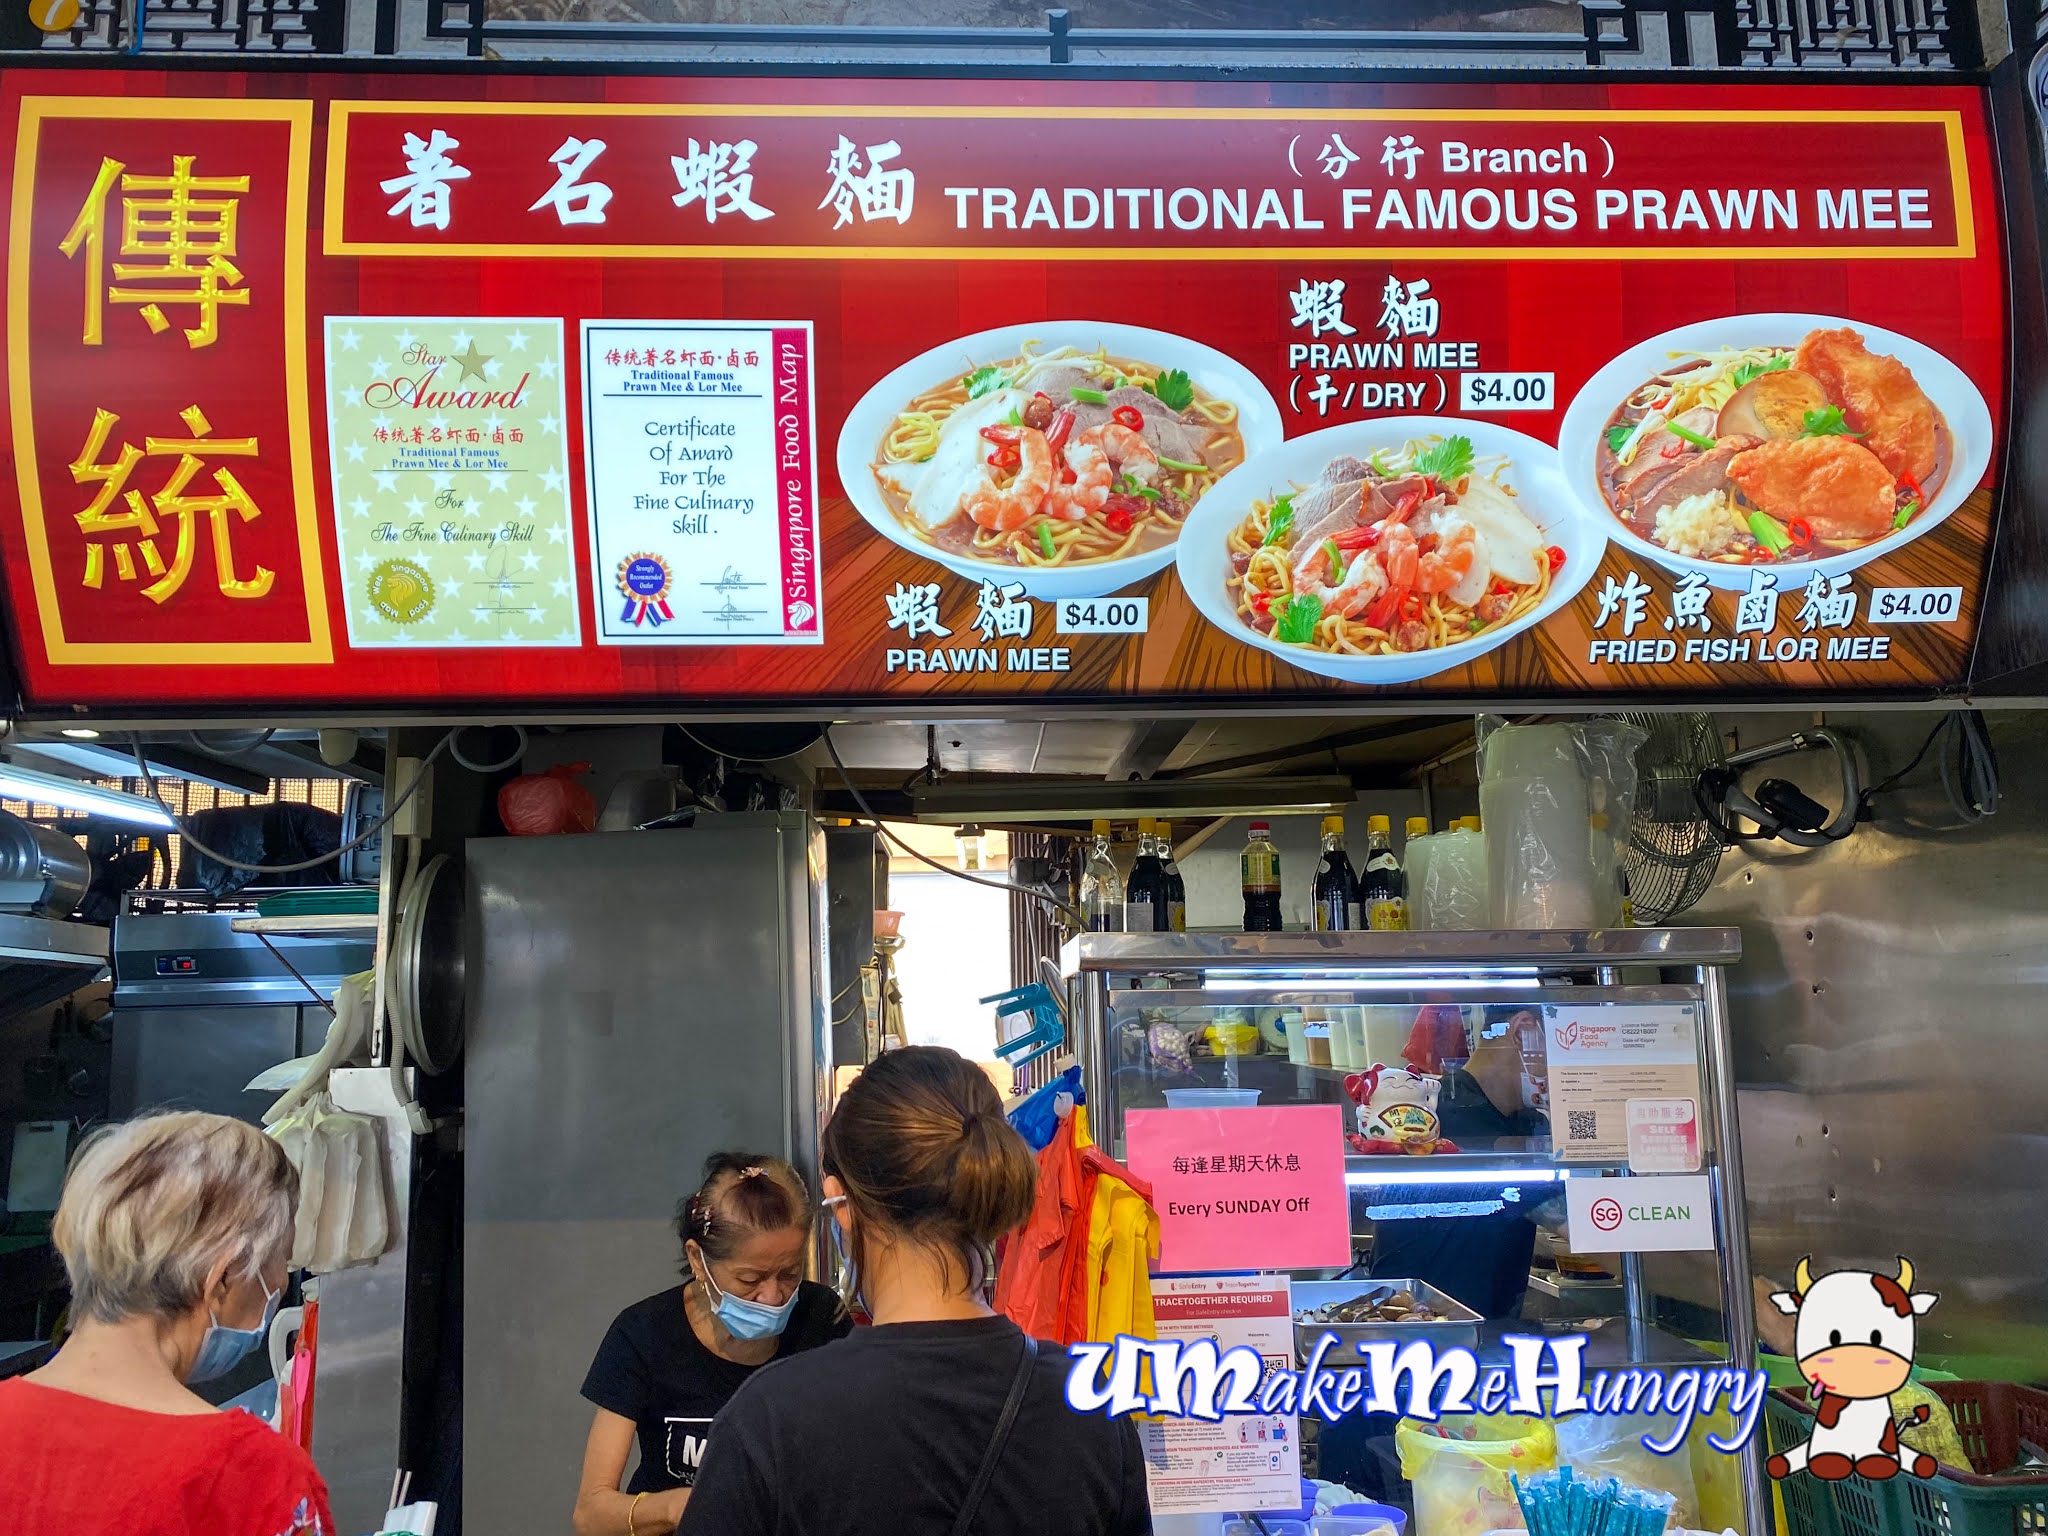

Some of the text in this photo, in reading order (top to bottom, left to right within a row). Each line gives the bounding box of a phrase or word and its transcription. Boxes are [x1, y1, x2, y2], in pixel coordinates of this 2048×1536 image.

[379, 128, 916, 231] 著名蝦麵
[944, 187, 1933, 231] TRADITIONAL FAMOUS PRAWN MEE
[1289, 274, 1441, 341] 蝦麵
[402, 342, 448, 365] Star
[1289, 342, 1480, 370] PRAWN MEE
[58, 154, 276, 605] 傳統
[623, 381, 743, 392] Prawn Mee & Lor Mee
[630, 369, 735, 381] Traditional Famous
[364, 366, 531, 409] Award
[1470, 376, 1547, 406] $4.00
[644, 416, 736, 441] Certificate
[392, 459, 509, 469] Prawn Mee & Lor Mee
[398, 447, 500, 457] Traditional Famous
[650, 441, 733, 466] Of Award
[659, 465, 726, 487] For The
[778, 343, 812, 599] Singapore Food Map
[434, 489, 464, 509] For
[633, 490, 754, 514] Fine Culinary
[371, 521, 535, 549] The Fine Culinary Skill
[629, 573, 663, 581] Recommended
[372, 564, 430, 618] Singapore Food Map Web
[885, 578, 1140, 643] 蝦麵 $4.00
[1593, 569, 1954, 638] 炸魚鹵麵 $4.00
[886, 648, 1071, 673] PRAWN MEE
[1588, 636, 1891, 665] FRIED FISH LOR MEE
[1579, 1026, 1617, 1034] Singapore
[1581, 1041, 1609, 1049] Agency
[1649, 1124, 1678, 1134] SELF
[1172, 1153, 1302, 1175] 每逢星期天休息
[1169, 1197, 1310, 1217] Every SUNDAY Off
[1595, 1206, 1691, 1221] SG CLEAN
[1178, 1282, 1207, 1291] SafeEntry
[1154, 1294, 1273, 1307] TRACETOGETHER REQUIRED
